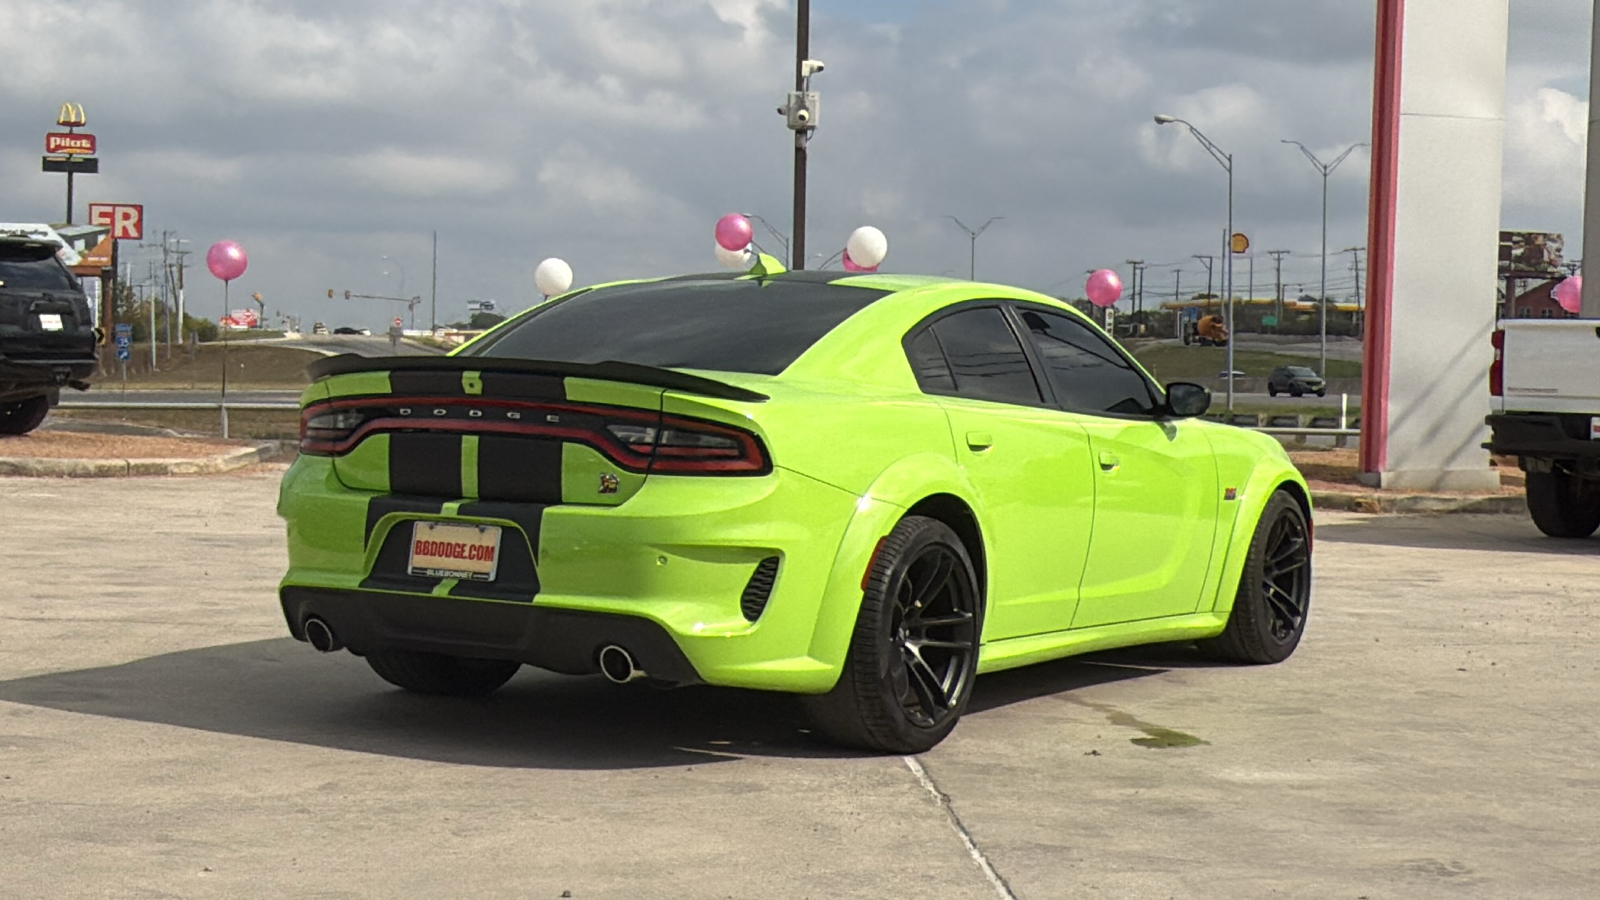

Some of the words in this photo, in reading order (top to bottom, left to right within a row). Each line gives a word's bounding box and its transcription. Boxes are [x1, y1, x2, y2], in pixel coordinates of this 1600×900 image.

[49, 136, 92, 149] Pilot
[399, 408, 560, 423] DODGE
[415, 540, 495, 562] BBDODGE.COM
